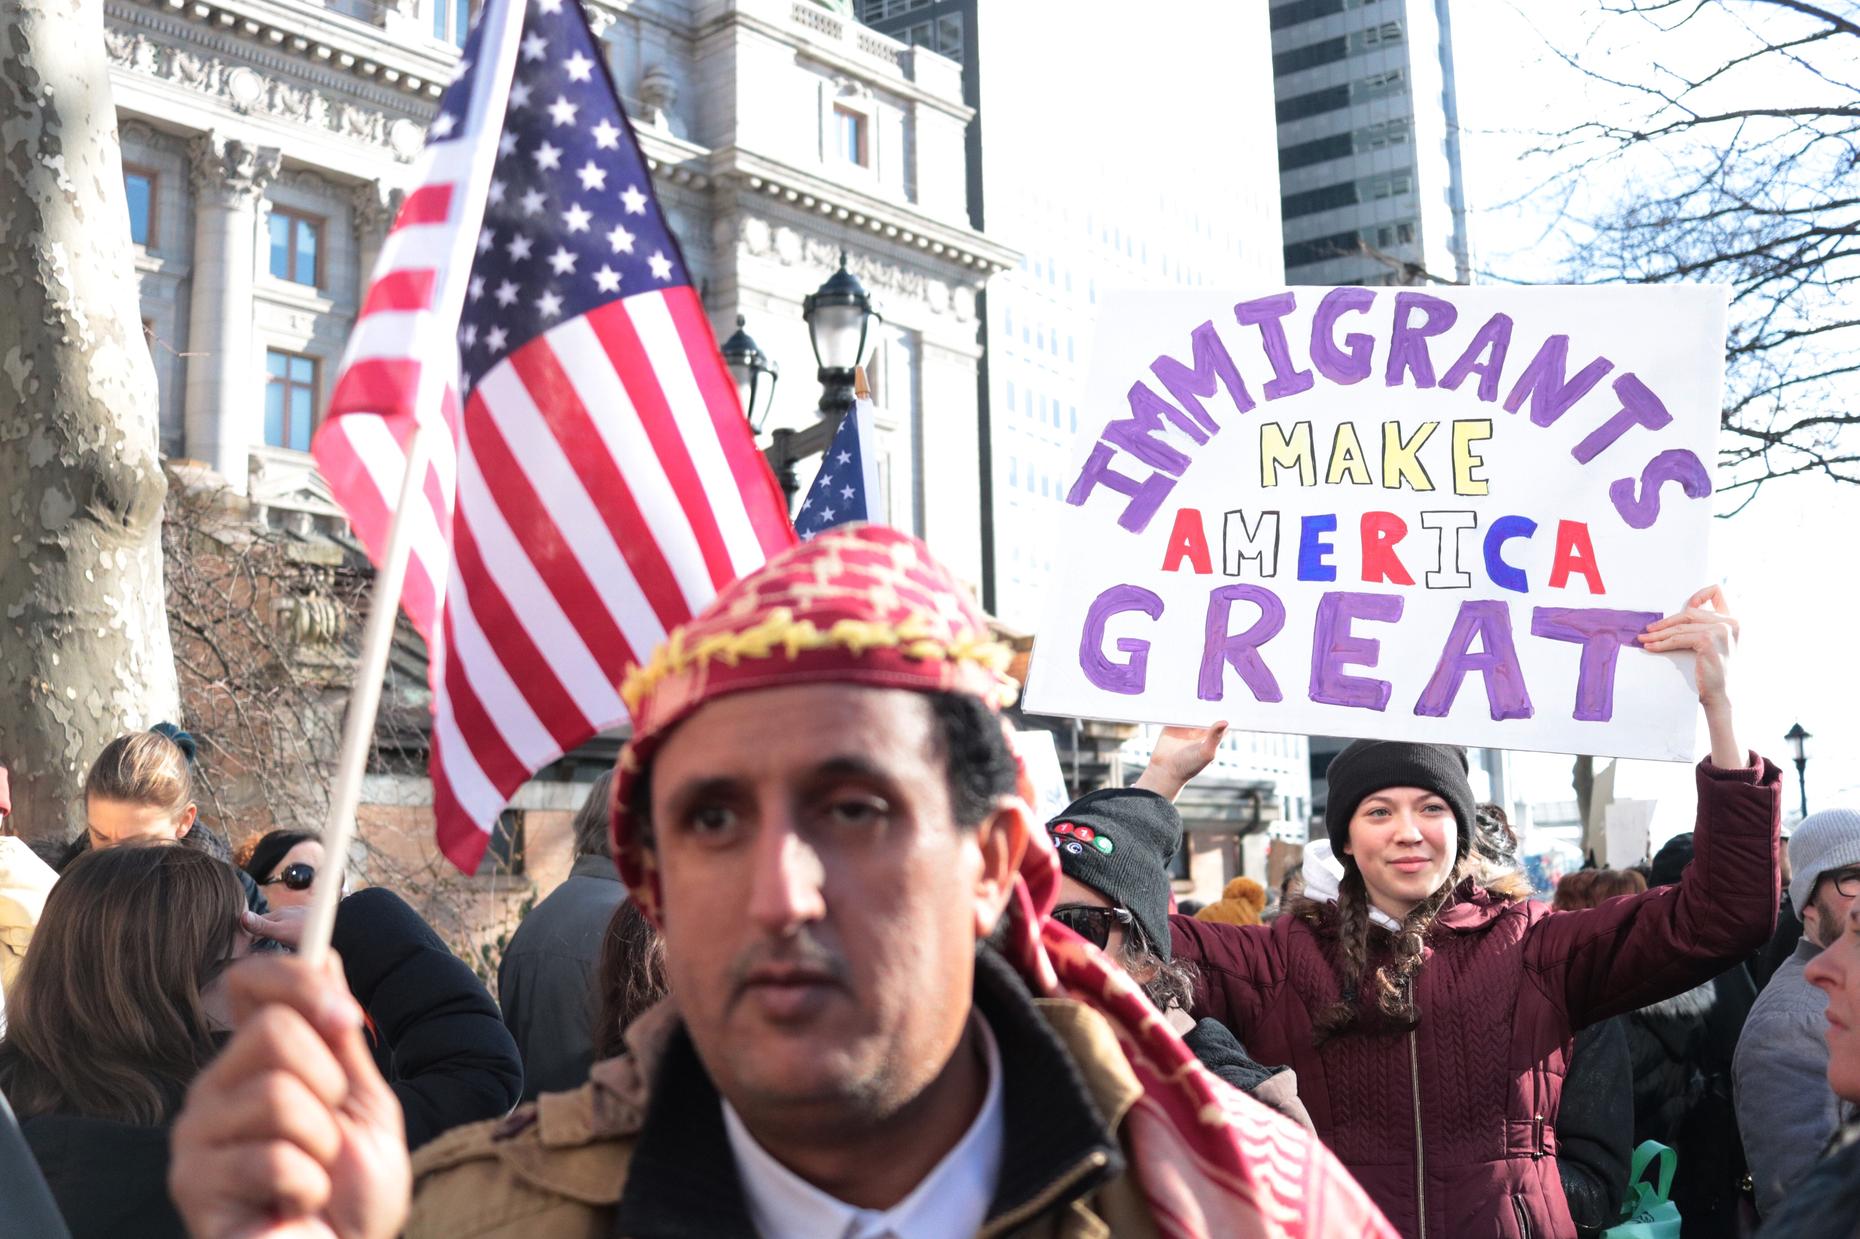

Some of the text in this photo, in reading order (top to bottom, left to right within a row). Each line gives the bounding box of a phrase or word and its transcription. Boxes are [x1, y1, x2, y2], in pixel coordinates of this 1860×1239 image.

[1067, 287, 1712, 534] IMMIGRANTS
[1260, 419, 1494, 496] MAKE
[1162, 508, 1606, 595] AMERICA
[1079, 584, 1664, 722] GREAT
